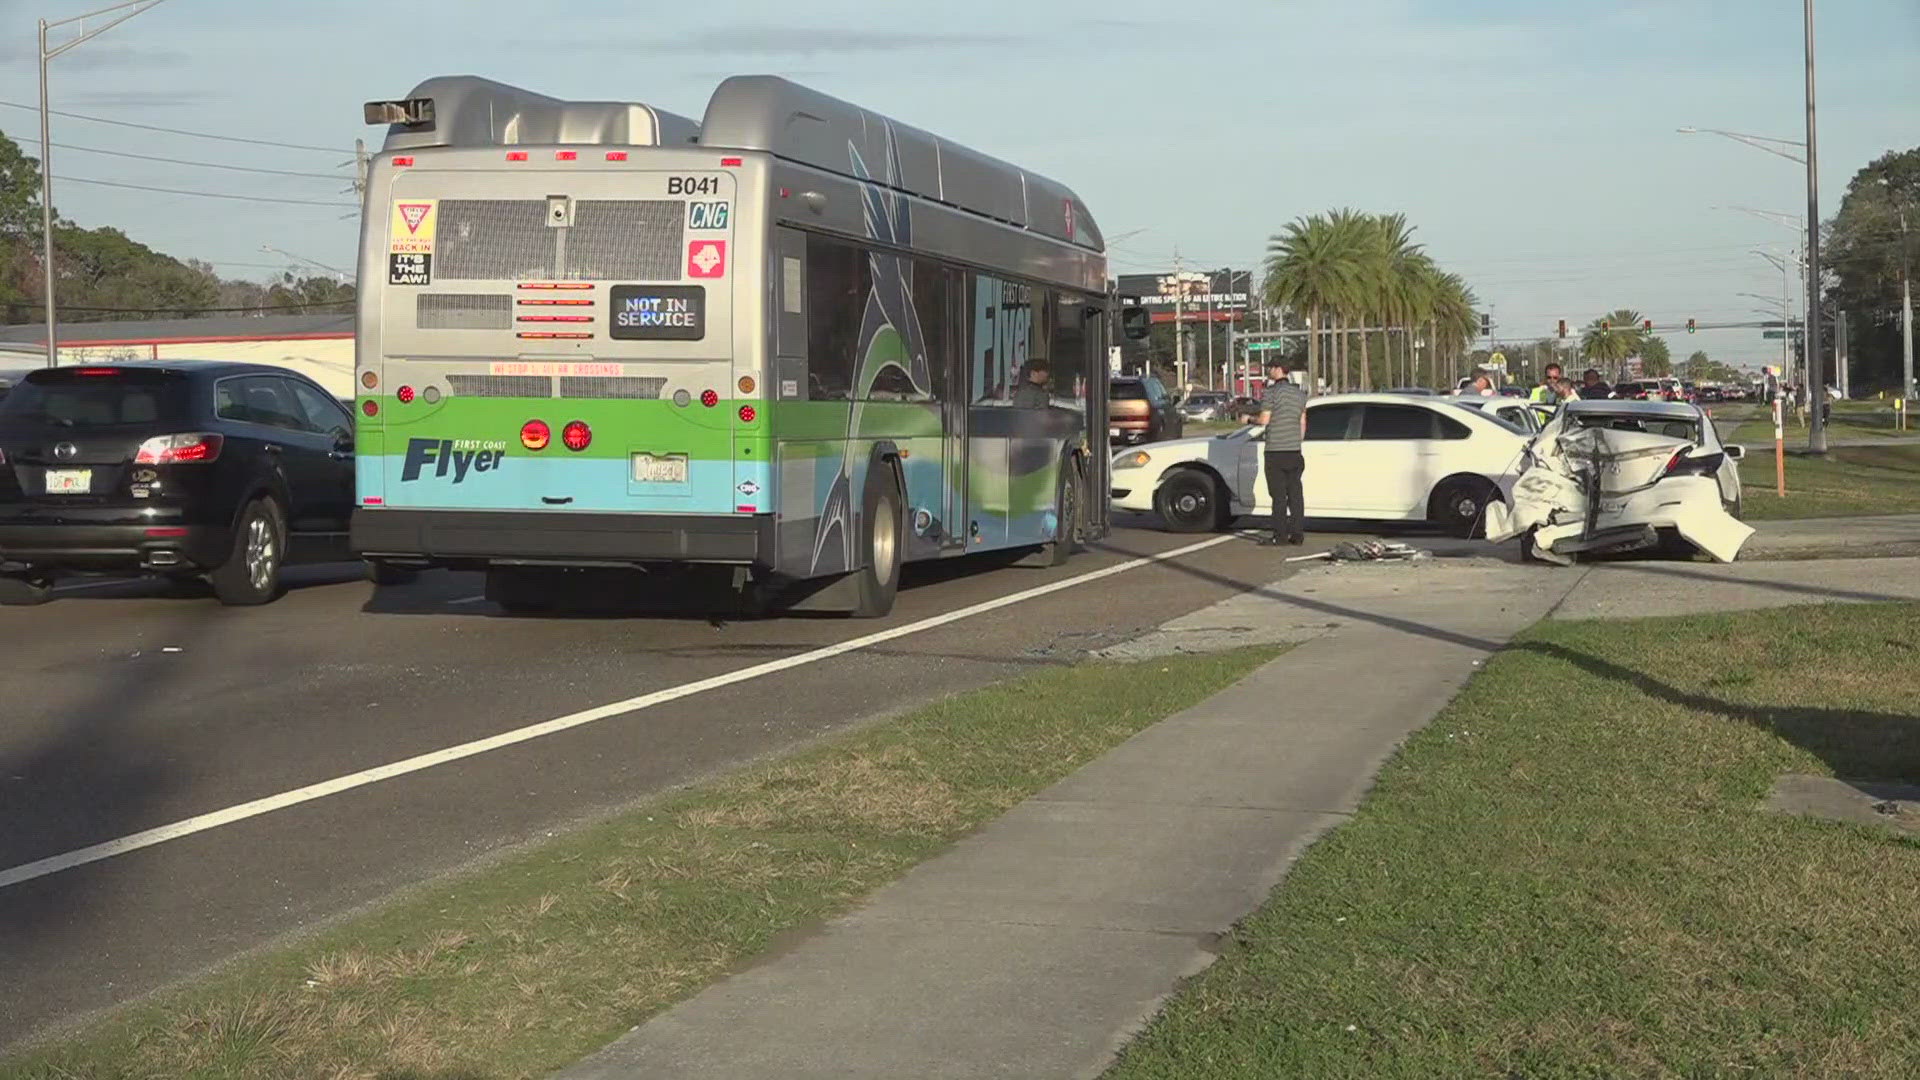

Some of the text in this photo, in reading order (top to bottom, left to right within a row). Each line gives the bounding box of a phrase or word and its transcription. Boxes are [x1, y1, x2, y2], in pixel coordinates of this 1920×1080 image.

[668, 177, 719, 195] B041
[689, 203, 728, 228] CNG
[392, 244, 418, 252] BACK
[397, 254, 425, 264] IT'S
[395, 264, 425, 274] THE
[391, 274, 428, 284] LAW!
[625, 298, 687, 312] NOT IN
[617, 312, 695, 326] SERVICE
[454, 440, 507, 449] FIRST COAST
[401, 437, 505, 484] Flyer
